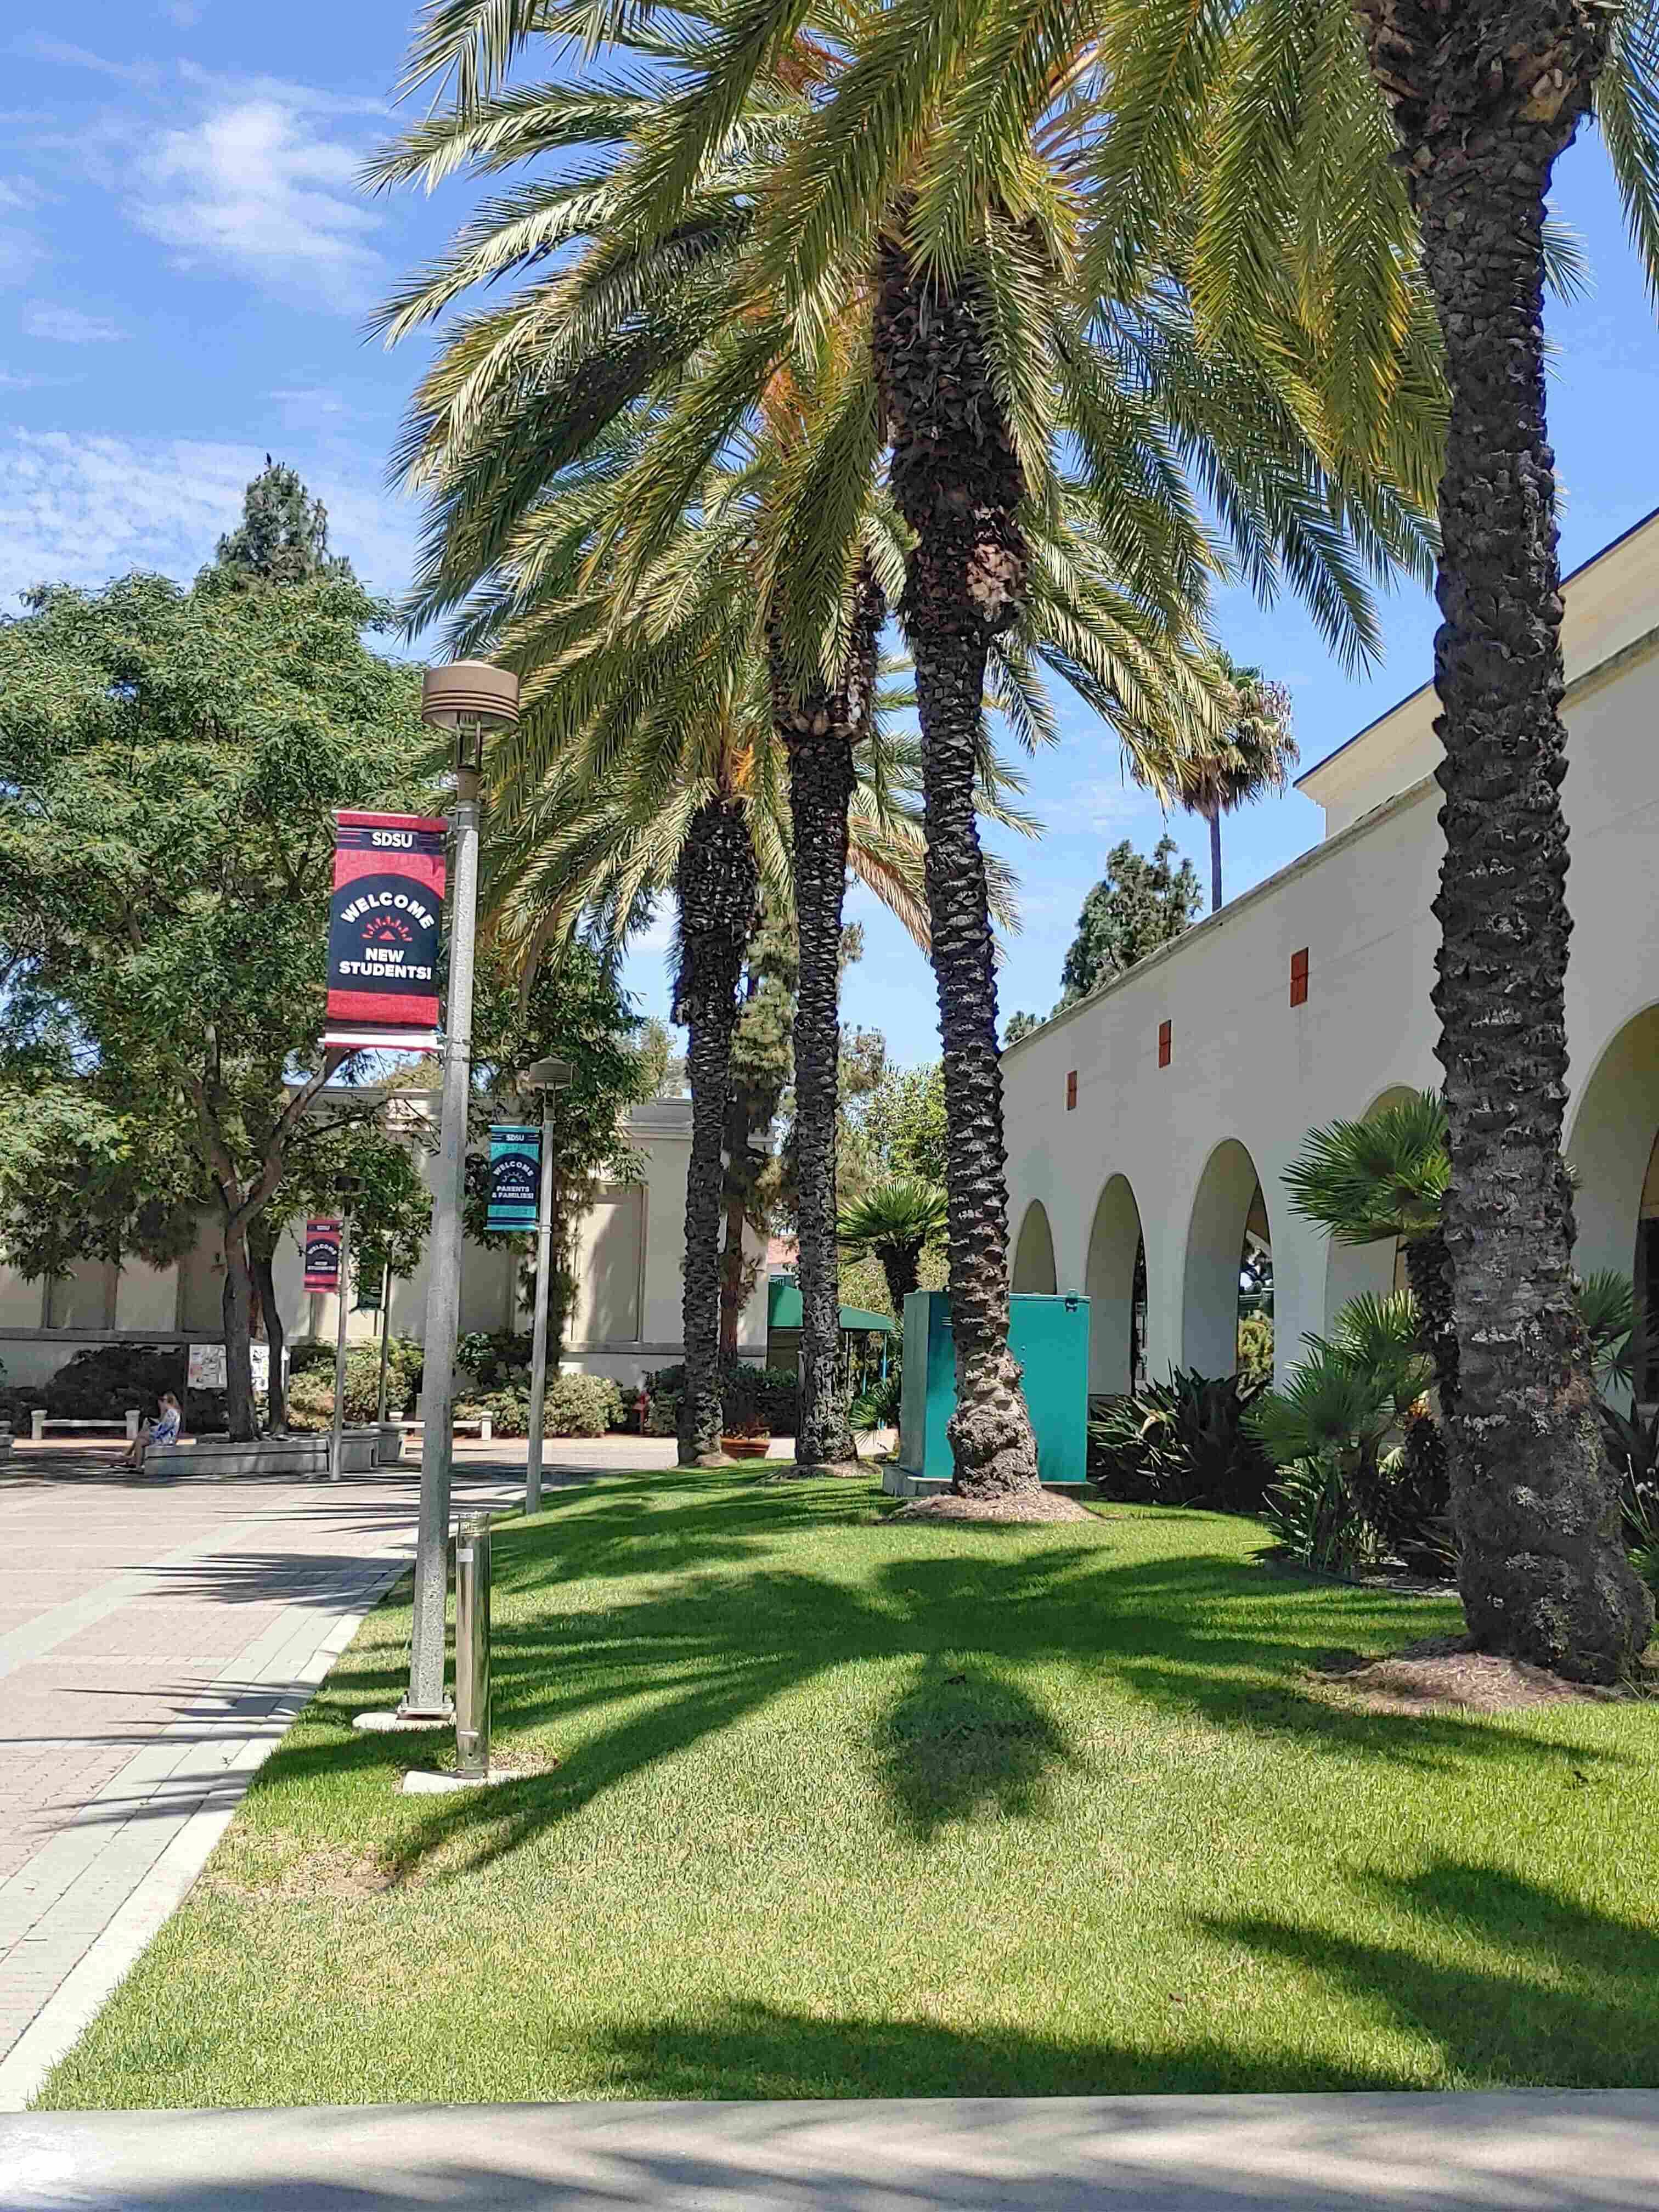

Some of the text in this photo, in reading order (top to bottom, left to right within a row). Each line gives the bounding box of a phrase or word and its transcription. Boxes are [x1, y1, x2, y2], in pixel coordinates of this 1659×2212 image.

[371, 832, 413, 849] SDSU
[340, 892, 435, 930] WELCOME
[365, 947, 404, 963] NEW
[338, 961, 432, 981] STUDENTS!
[493, 1161, 534, 1177] WELCOME
